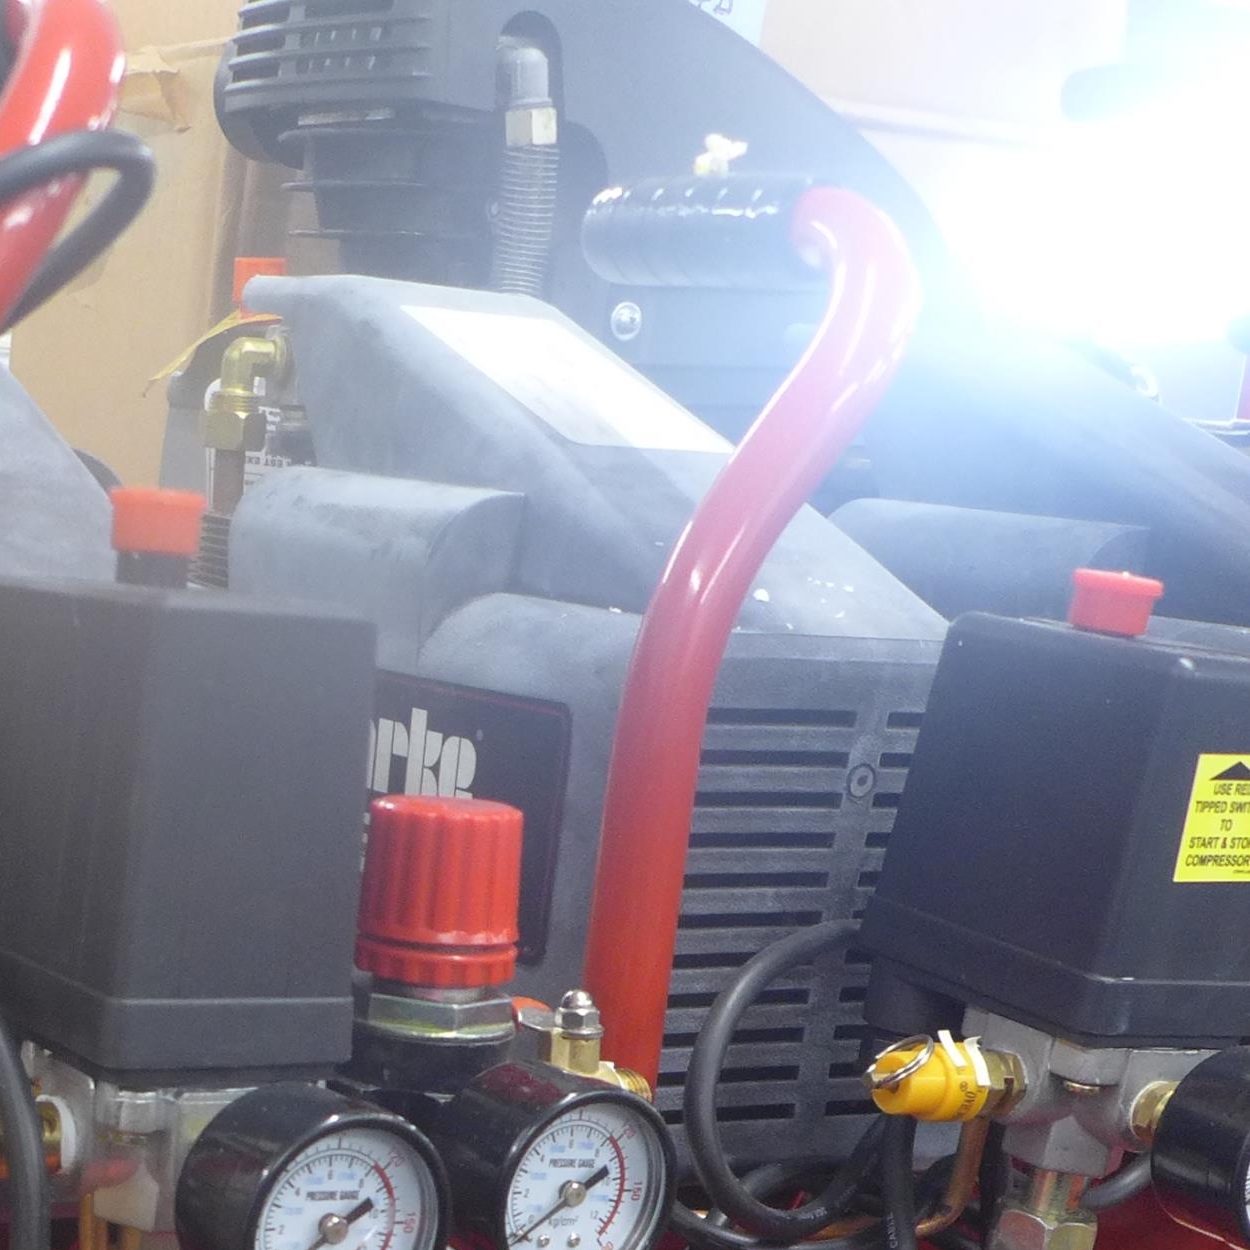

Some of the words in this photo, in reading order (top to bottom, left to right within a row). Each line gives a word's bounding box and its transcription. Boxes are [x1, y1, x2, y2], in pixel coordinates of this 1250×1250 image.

[1213, 783, 1232, 796] USE
[1195, 800, 1228, 814] TIPPED
[1220, 818, 1232, 832] TO
[1189, 836, 1220, 849] START
